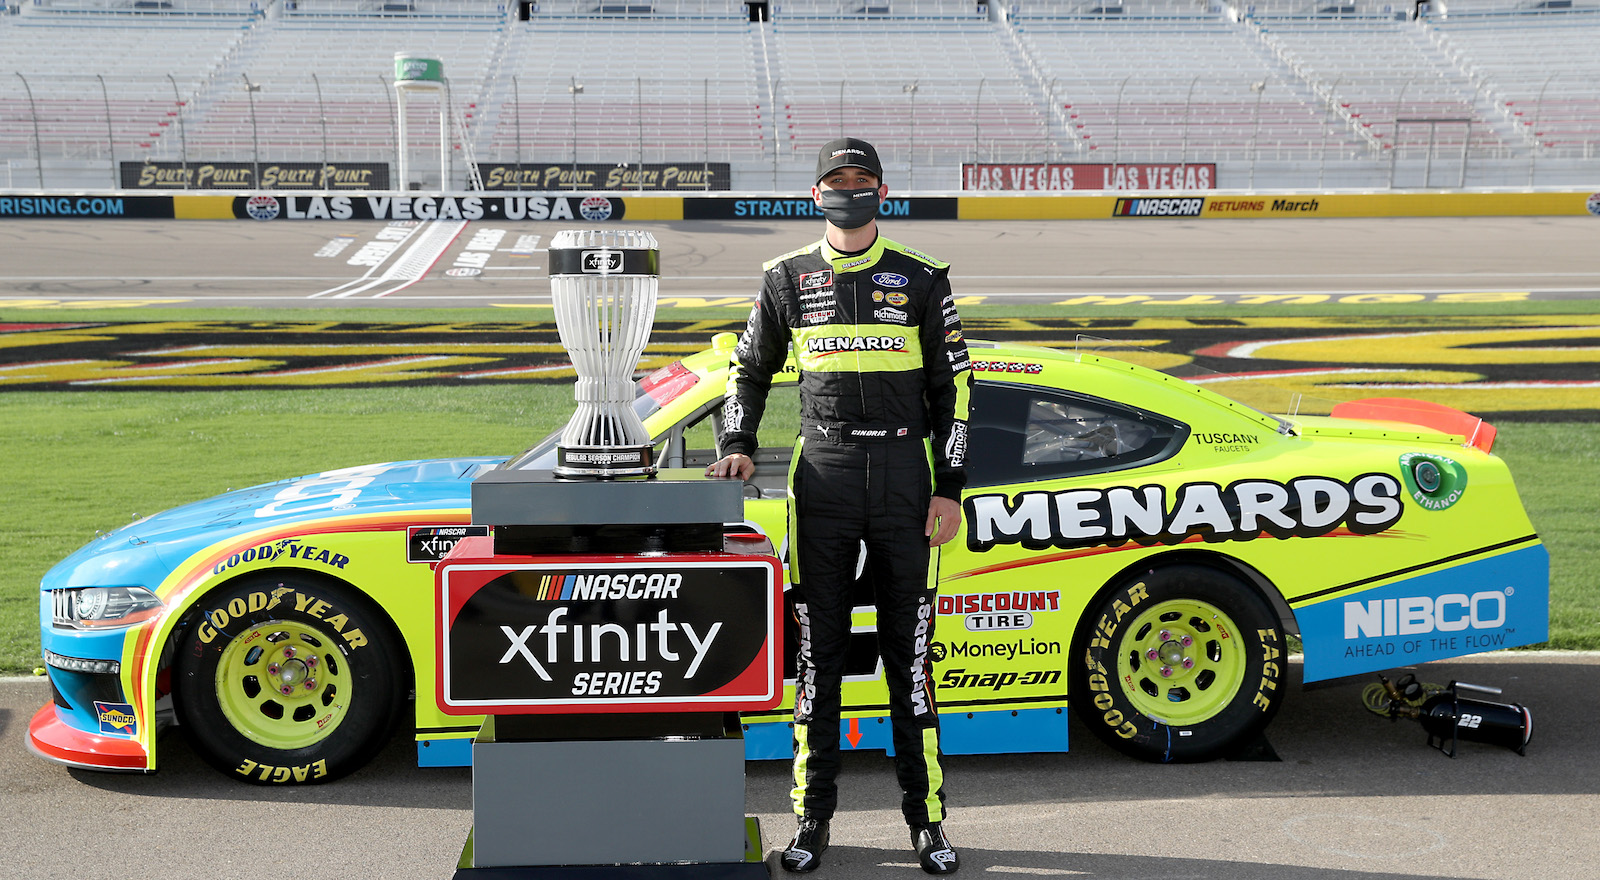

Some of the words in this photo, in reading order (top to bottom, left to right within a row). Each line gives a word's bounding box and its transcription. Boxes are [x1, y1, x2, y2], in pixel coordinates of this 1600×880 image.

[198, 165, 252, 187] POINT
[261, 166, 315, 186] SOUTH
[319, 165, 373, 187] POINT
[605, 167, 659, 187] SOUTH
[662, 166, 714, 188] POINT
[967, 168, 1003, 190] LAS
[1011, 167, 1075, 190] VEGAS
[1103, 167, 1138, 190] LAS
[1146, 167, 1210, 189] VEGAS
[0, 198, 124, 215] RISING.COM
[286, 196, 353, 219] LAS
[369, 197, 484, 220] VEGAS
[504, 198, 574, 220] USA
[1135, 199, 1203, 216] NASCAR
[1208, 201, 1265, 212] RETURNS
[1271, 199, 1319, 212] March
[879, 274, 902, 286] Ford
[806, 300, 837, 309] MoneyLion
[874, 309, 908, 321] Richmond
[809, 336, 906, 353] MENARDS
[1193, 433, 1259, 444] TUSCANY
[588, 454, 612, 462] SEASON
[970, 475, 1402, 545] MENARDS
[1414, 490, 1462, 509] ETHANOL
[439, 528, 467, 536] NASCAR
[571, 573, 683, 600] NASCAR
[937, 592, 1061, 615] DISCOUNT
[971, 614, 1025, 628] TIRE
[1344, 591, 1506, 639] NIBCO
[499, 607, 723, 682] xfinity
[951, 638, 1061, 660] MoneyLion
[1344, 642, 1395, 658] AHEAD
[1403, 640, 1422, 653] OF
[1431, 637, 1457, 651] THE
[911, 603, 931, 716] MENARDS
[1256, 628, 1282, 713] EAGLE
[571, 671, 664, 695] SERIES
[937, 668, 1062, 691] Snap-on
[102, 713, 134, 724] SUNOCO
[1458, 713, 1482, 728] 22
[236, 758, 328, 783] EAGLE
